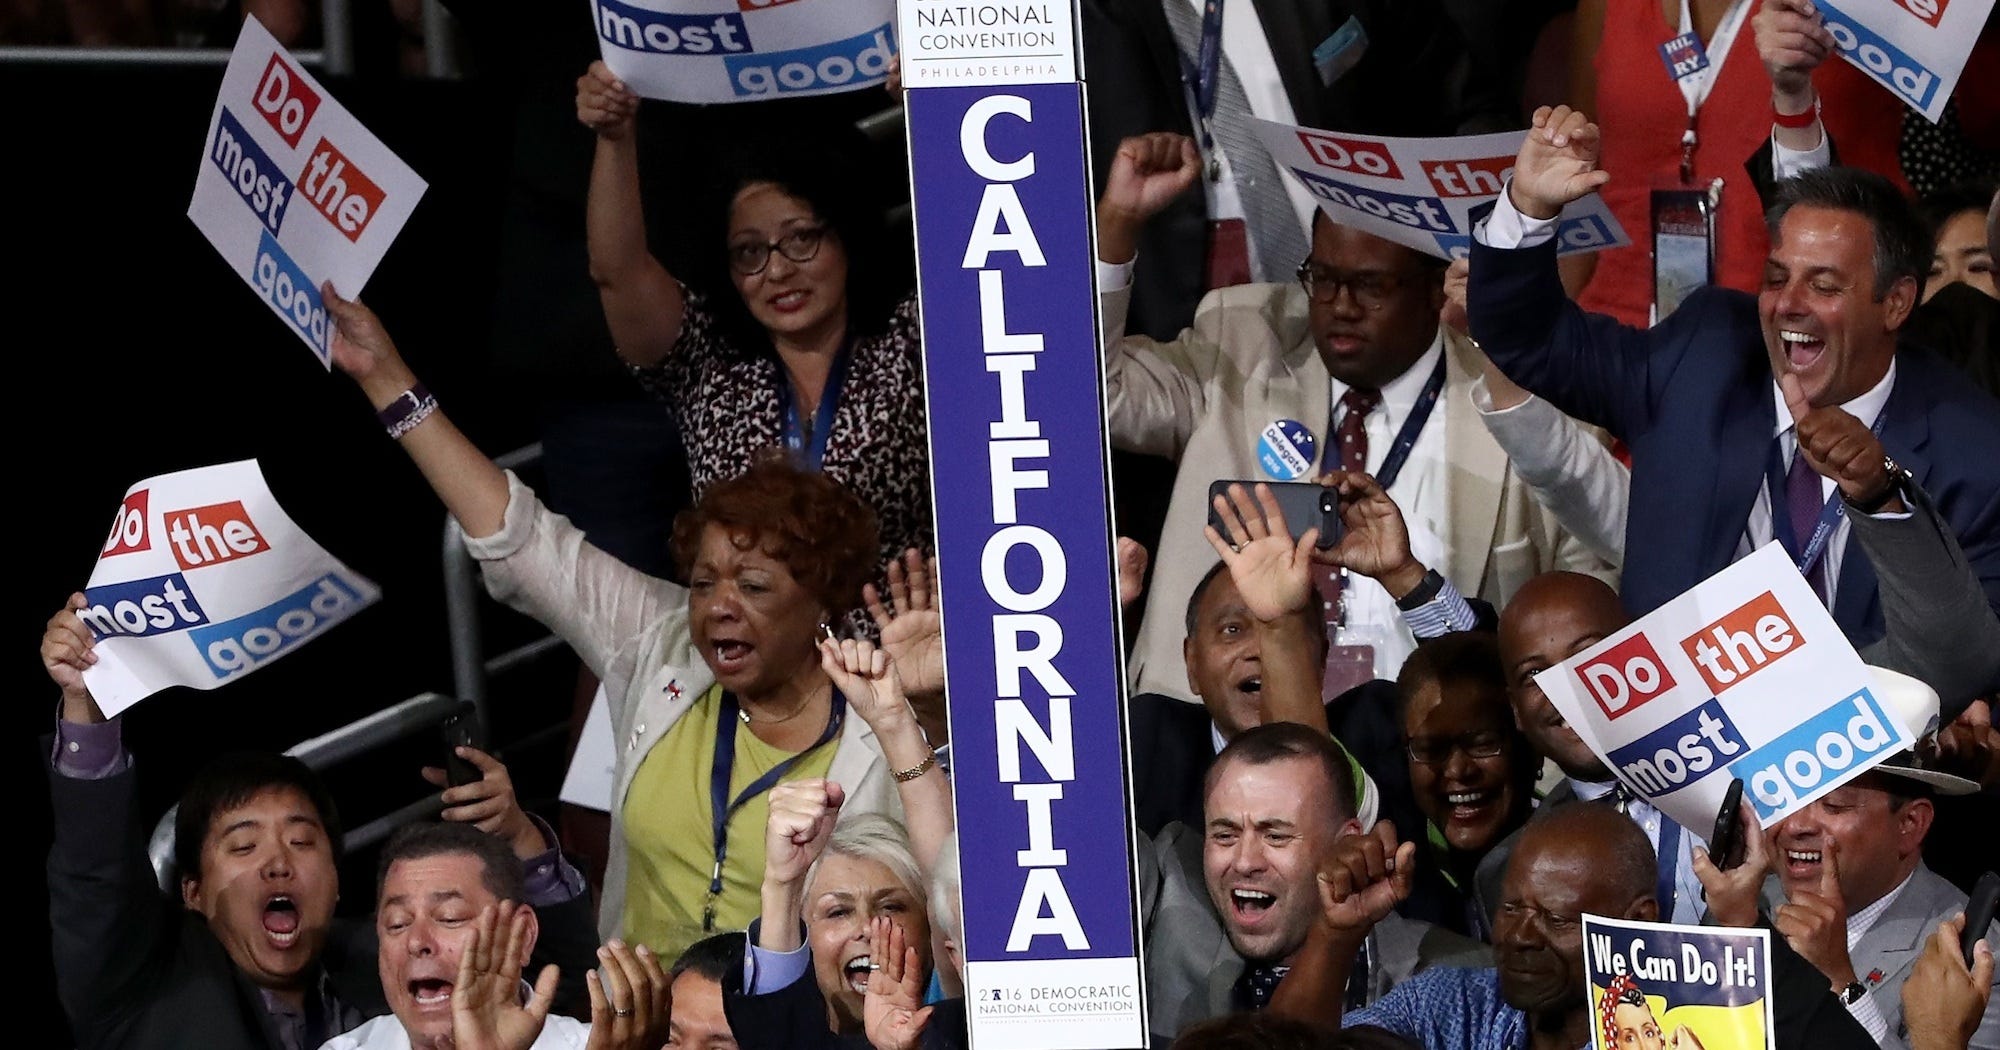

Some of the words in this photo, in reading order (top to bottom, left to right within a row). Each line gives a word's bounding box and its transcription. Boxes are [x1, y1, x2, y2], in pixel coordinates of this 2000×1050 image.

[601, 5, 744, 51] most
[917, 5, 1053, 27] NATIONAL
[919, 32, 1055, 50] CONVENTION
[738, 31, 896, 95] good
[920, 65, 1057, 78] PHILADELPHIA
[1664, 36, 1694, 55] HIL
[1673, 55, 1699, 76] RY
[1824, 21, 1932, 103] ood
[258, 61, 305, 135] Do
[304, 151, 369, 232] the
[1306, 136, 1390, 174] Do
[215, 125, 287, 230] most
[1304, 177, 1450, 231] most
[256, 252, 328, 351] good
[1266, 428, 1304, 473] Delegate
[170, 513, 259, 565] the
[960, 94, 1091, 953] CALIFORNIA
[76, 578, 201, 638] most
[207, 580, 350, 677] good
[1583, 656, 1661, 714] Do
[1695, 613, 1795, 685] the
[1622, 708, 1741, 795] most
[1751, 695, 1892, 811] good
[1590, 933, 1627, 976] We
[1630, 938, 1678, 982] Can
[1681, 942, 1718, 986] Do
[1724, 946, 1757, 988] It!
[979, 1003, 1041, 1014] NATIONAL
[1049, 1001, 1134, 1012] CONVENTION
[1030, 985, 1133, 1000] DEMOCRATIC
